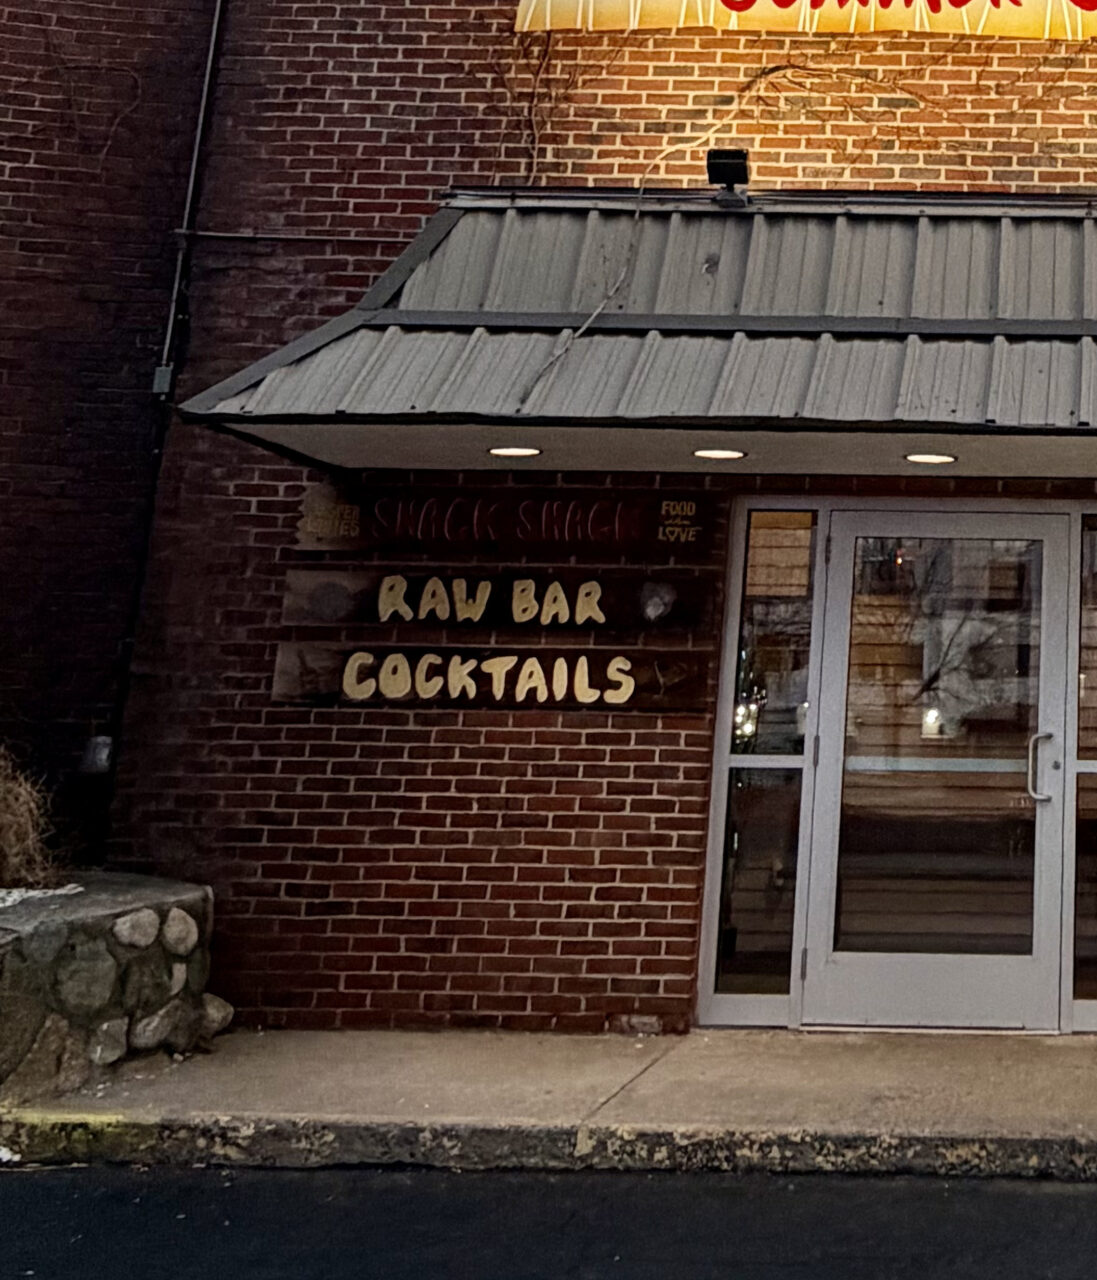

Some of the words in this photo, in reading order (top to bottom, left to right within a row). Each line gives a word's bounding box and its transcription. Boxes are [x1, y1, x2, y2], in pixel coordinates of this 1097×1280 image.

[660, 500, 697, 517] FOOD
[656, 525, 703, 543] LOVE
[378, 575, 492, 623] RAW
[511, 578, 606, 625] BAR
[342, 651, 636, 704] COCKTAILS
